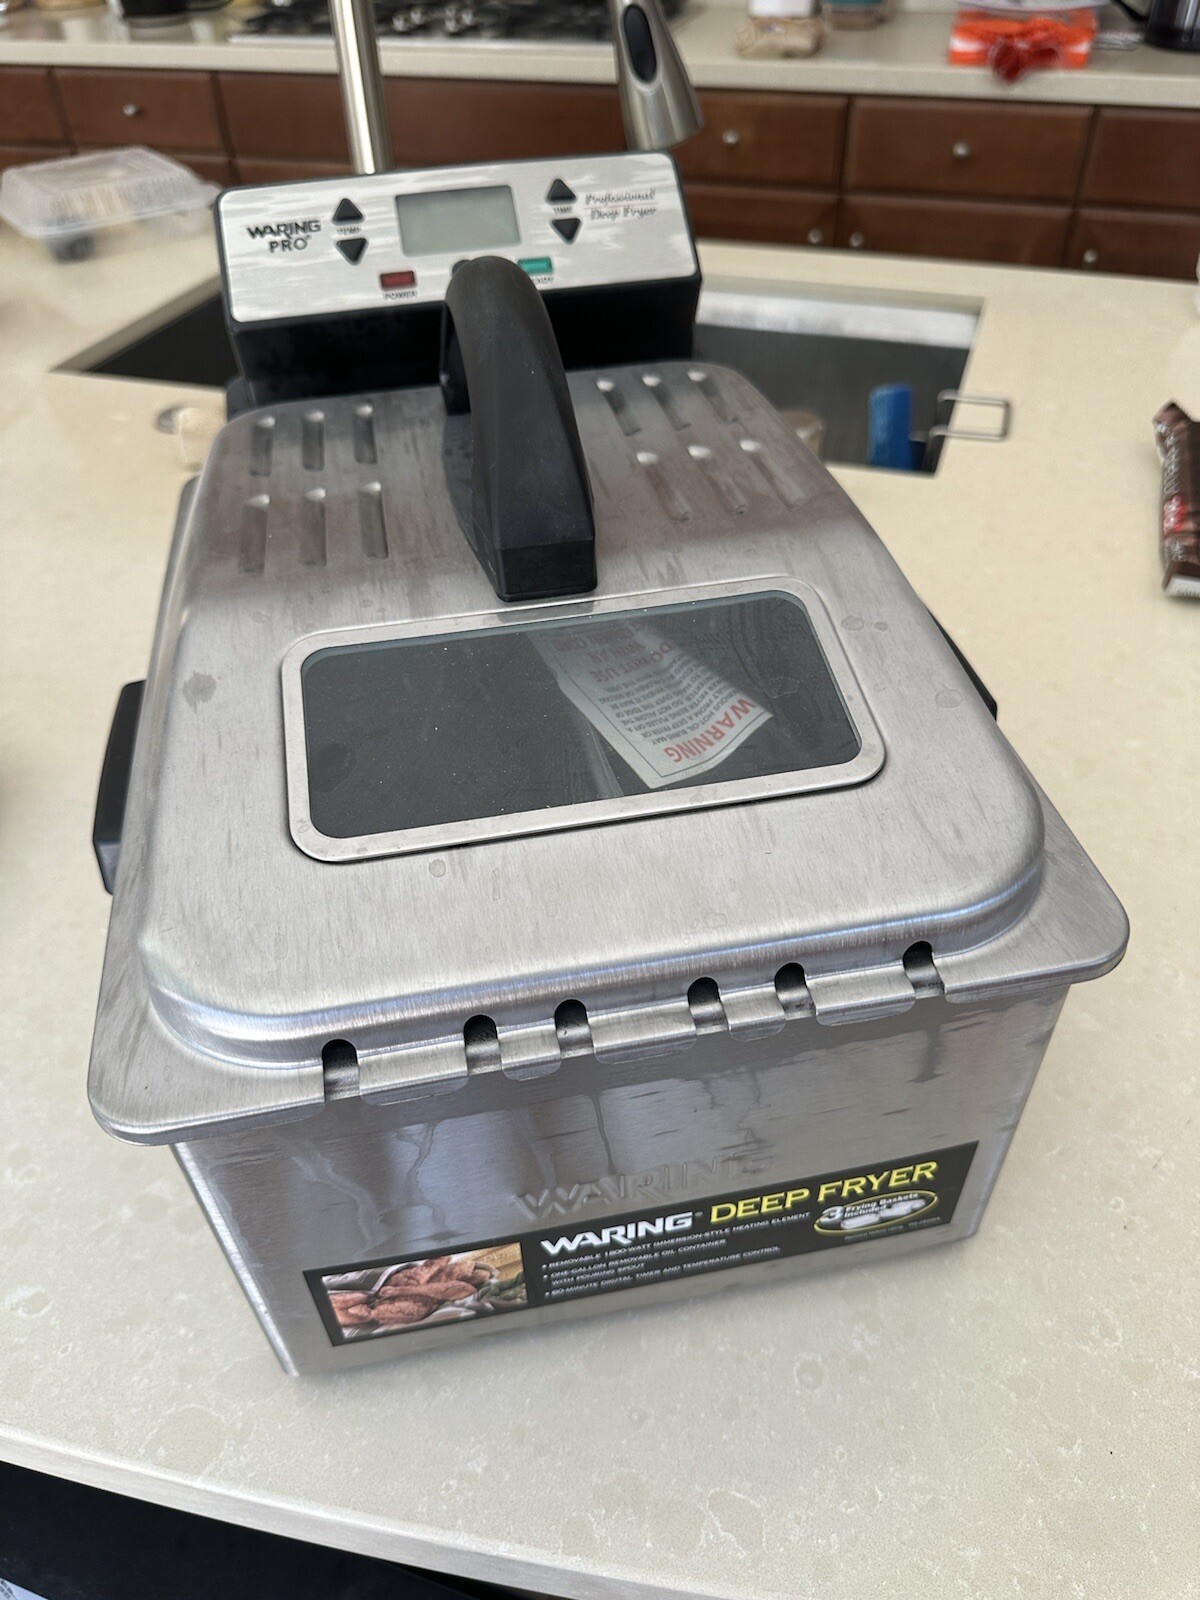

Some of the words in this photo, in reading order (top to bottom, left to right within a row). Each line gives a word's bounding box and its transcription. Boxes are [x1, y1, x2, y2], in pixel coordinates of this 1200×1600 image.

[247, 220, 321, 239] WARING
[269, 238, 308, 253] PRO
[384, 289, 417, 300] POWER
[651, 735, 666, 745] MAY
[662, 698, 756, 764] WARNING
[541, 1212, 693, 1255] WARING
[710, 1188, 810, 1223] DEEP
[818, 1161, 938, 1203] FRYER
[820, 1206, 845, 1223] 3
[846, 1201, 878, 1213] Frying
[880, 1193, 919, 1205] Baskets
[844, 1204, 887, 1218] Included
[548, 1252, 601, 1268] REMOVABLE
[732, 1219, 769, 1233] HEATING
[771, 1211, 811, 1225] ELEMENT
[608, 1252, 660, 1267] REMOVABLE
[677, 1238, 727, 1253] CONTAINER
[662, 1264, 682, 1274] AND
[683, 1253, 741, 1269] TEMPERATURE
